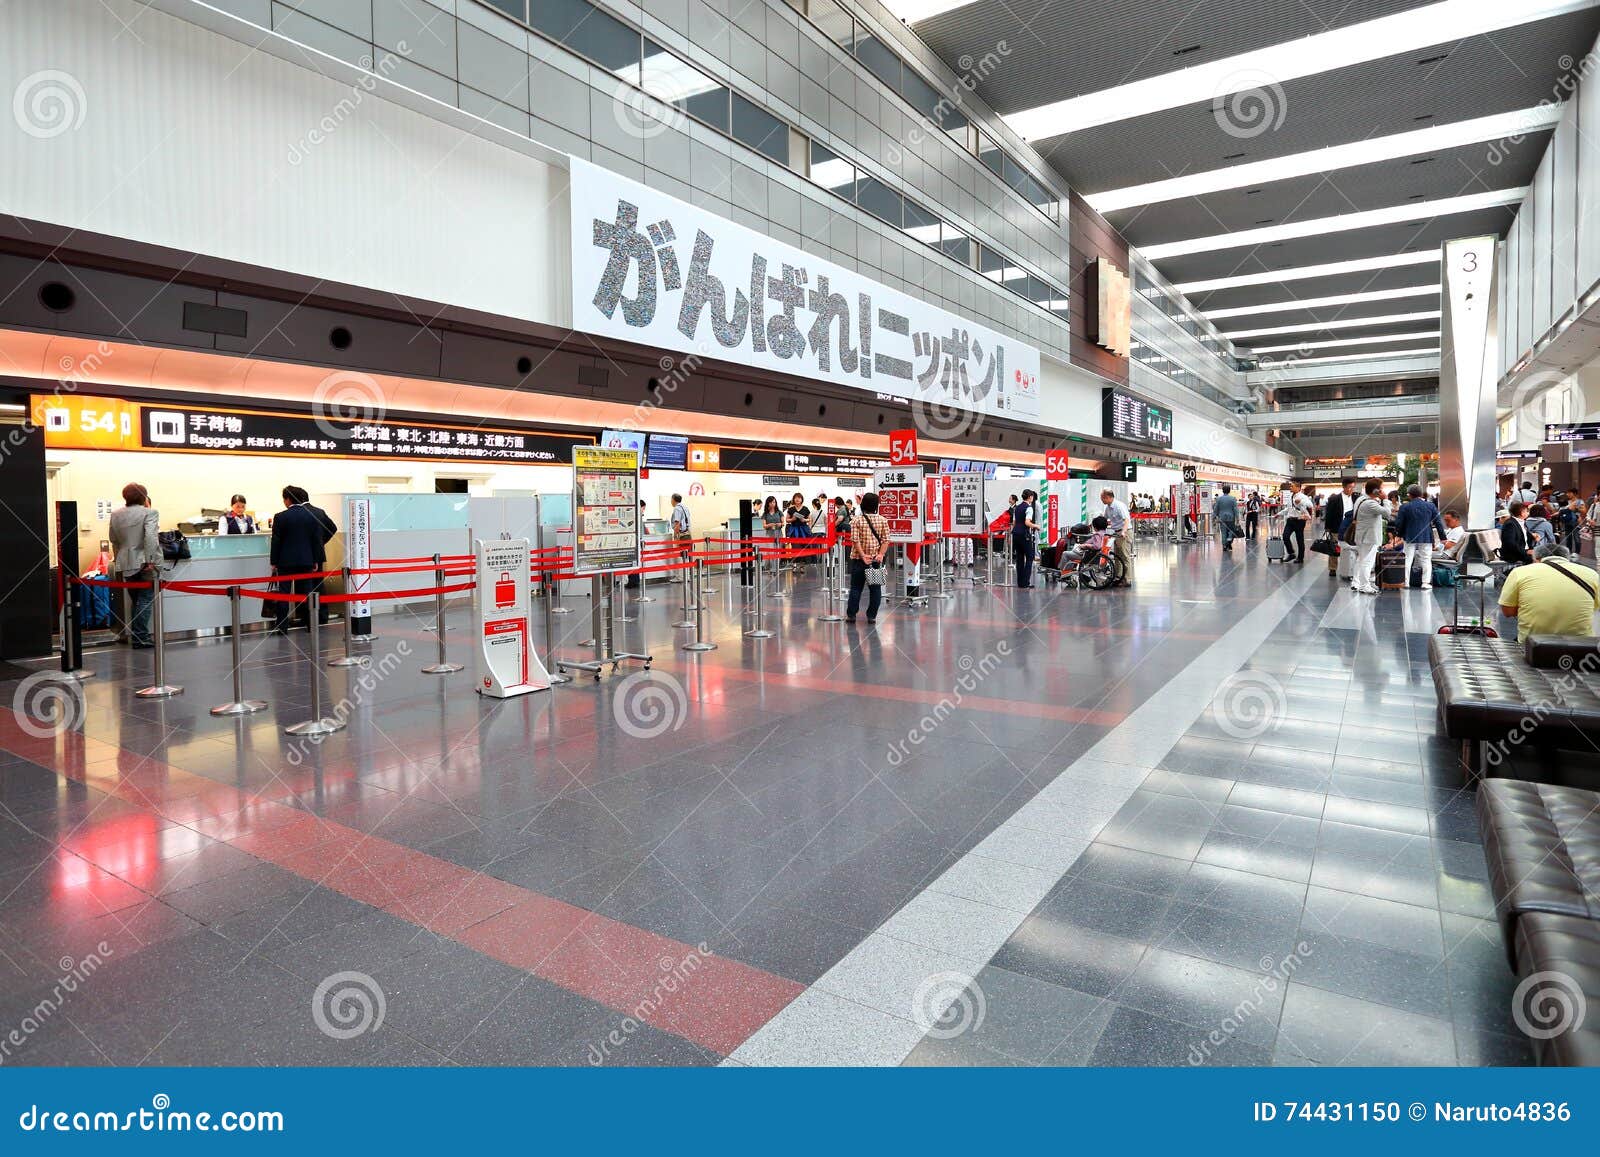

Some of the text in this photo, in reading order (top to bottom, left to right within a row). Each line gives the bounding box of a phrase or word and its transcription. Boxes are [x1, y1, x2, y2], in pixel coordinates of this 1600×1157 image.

[1462, 252, 1478, 272] 3
[81, 410, 115, 432] 54
[189, 415, 243, 432] 手荷物
[190, 434, 243, 448] Baggage
[708, 452, 719, 463] 56
[892, 439, 915, 462] 54
[1048, 457, 1067, 473] 56
[1125, 466, 1133, 478] F
[1184, 469, 1196, 479] 60
